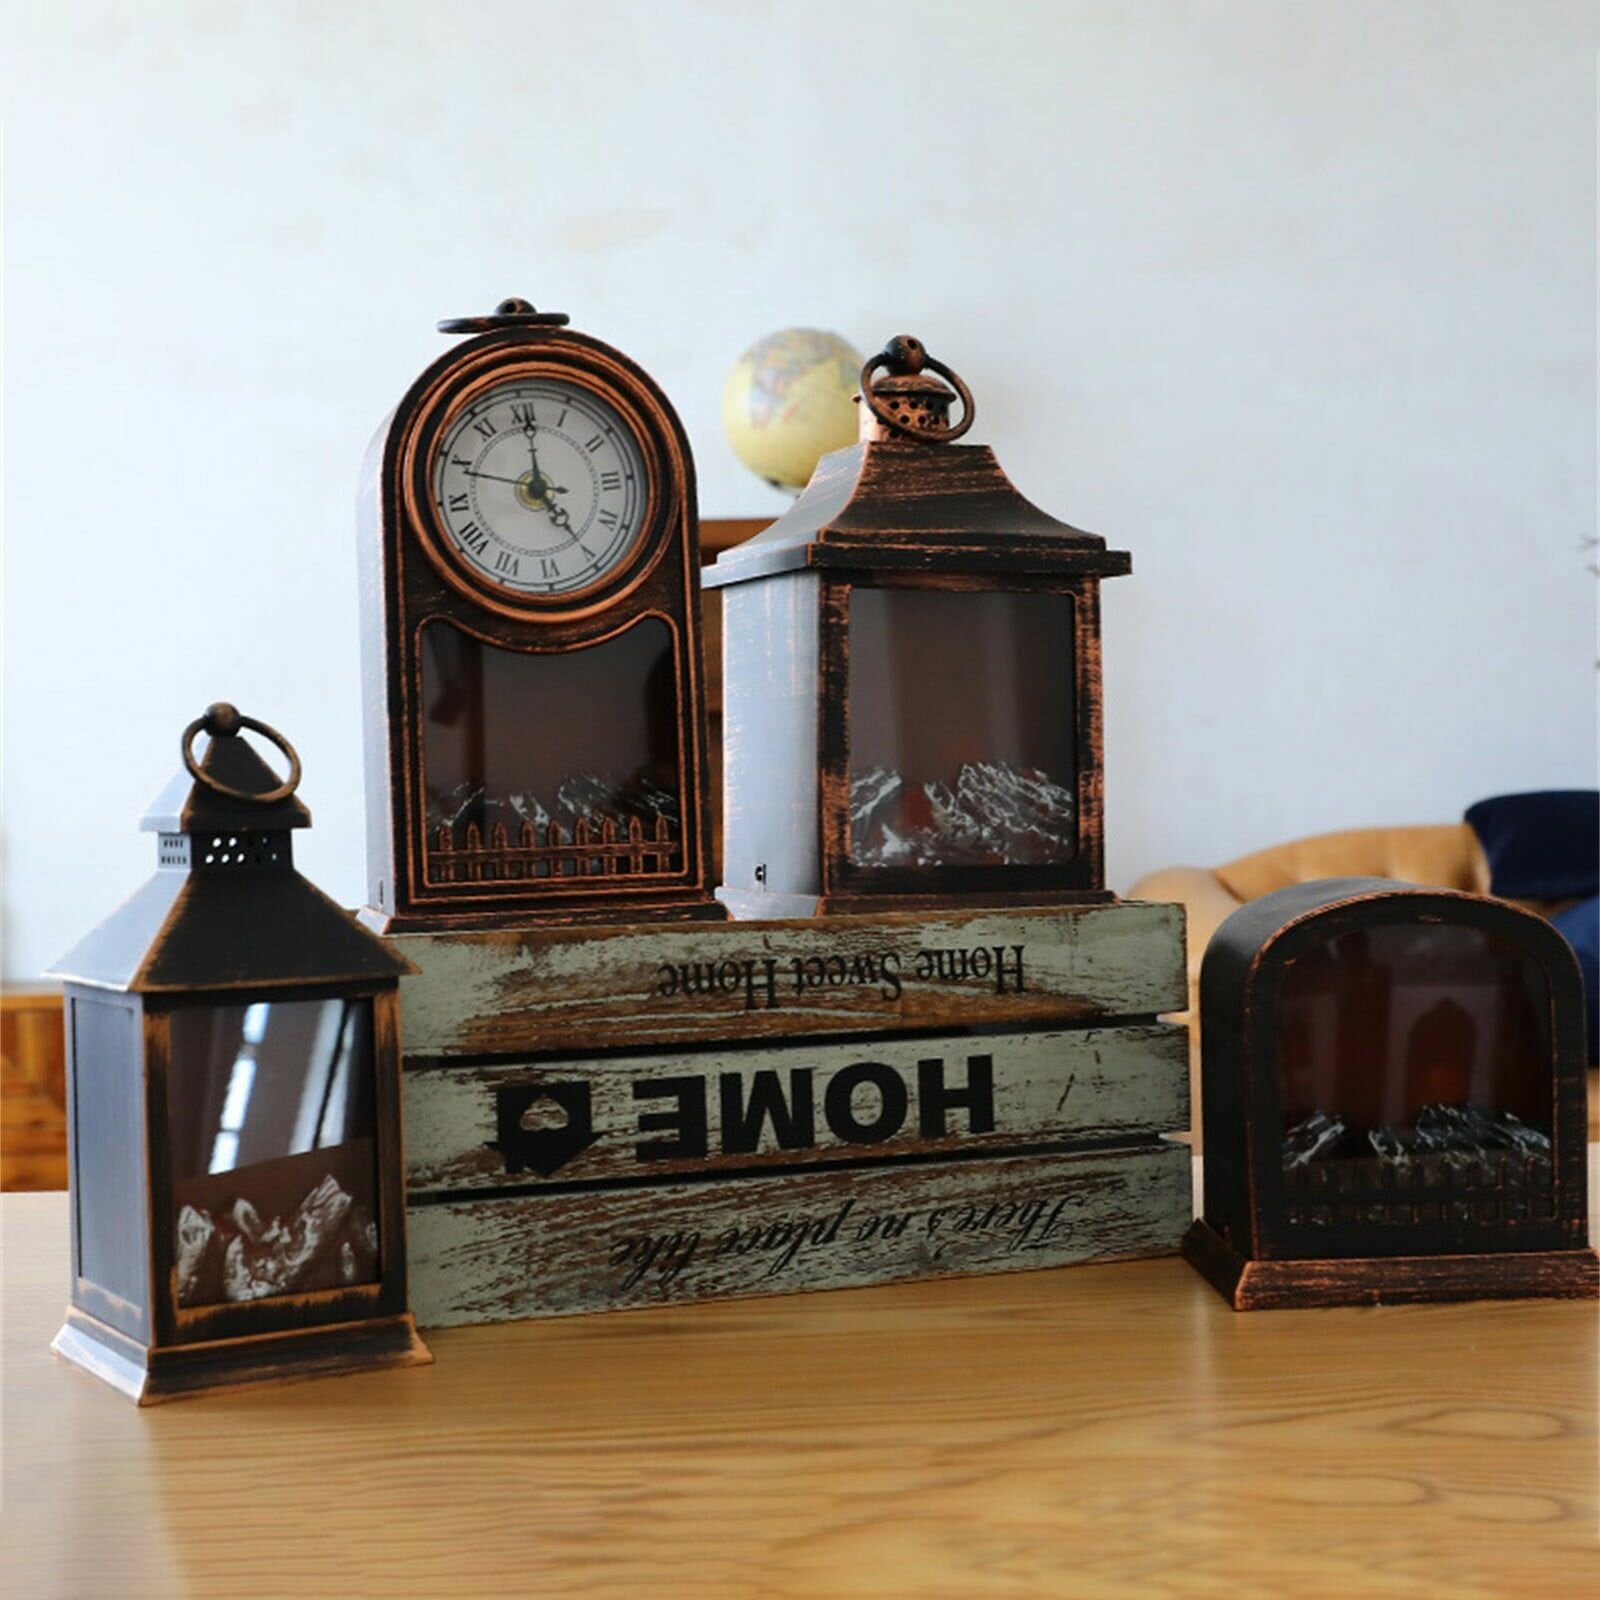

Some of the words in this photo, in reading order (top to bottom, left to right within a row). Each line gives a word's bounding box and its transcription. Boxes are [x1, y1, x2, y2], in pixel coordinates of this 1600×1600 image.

[473, 417, 497, 442] XI
[585, 433, 605, 453] II
[451, 454, 472, 472] X
[601, 471, 620, 491] III
[449, 493, 469, 512] IX
[598, 508, 618, 532] IV
[459, 521, 490, 556] VIII
[494, 551, 519, 577] VII
[580, 544, 596, 562] V
[541, 558, 560, 579] VI
[790, 952, 902, 1003] Sweet
[915, 945, 1028, 995] Home
[656, 958, 781, 1011] Home
[632, 1053, 995, 1163] HOME
[716, 1199, 856, 1277] place
[856, 1213, 909, 1243] no
[926, 1195, 1084, 1261] There's
[607, 1231, 701, 1291] like
